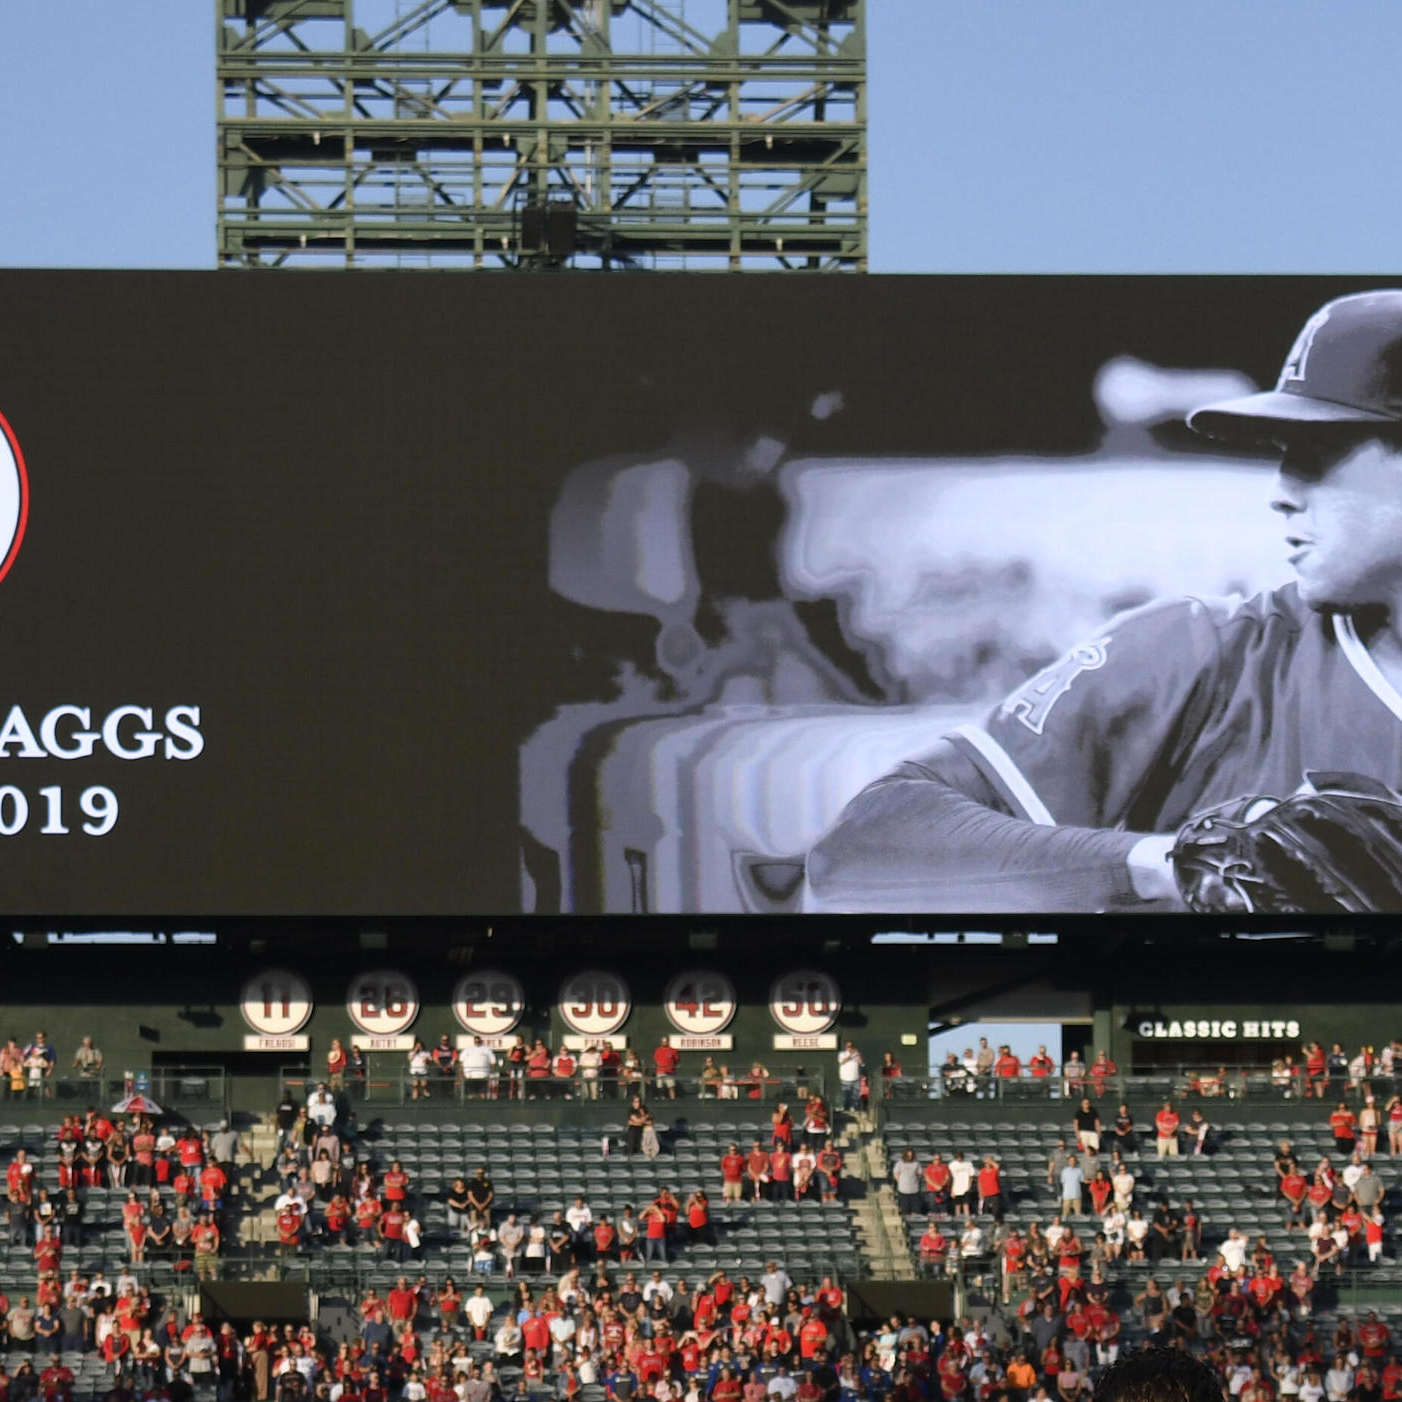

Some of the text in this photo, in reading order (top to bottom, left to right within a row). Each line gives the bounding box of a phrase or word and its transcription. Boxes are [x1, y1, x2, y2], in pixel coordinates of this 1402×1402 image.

[262, 978, 289, 1018] 11
[360, 983, 407, 1018] 26
[466, 982, 513, 1018] 29
[571, 982, 618, 1018] 30
[675, 982, 723, 1018] 42
[781, 982, 829, 1018] 50
[1138, 1020, 1300, 1038] CLASSIC HITS
